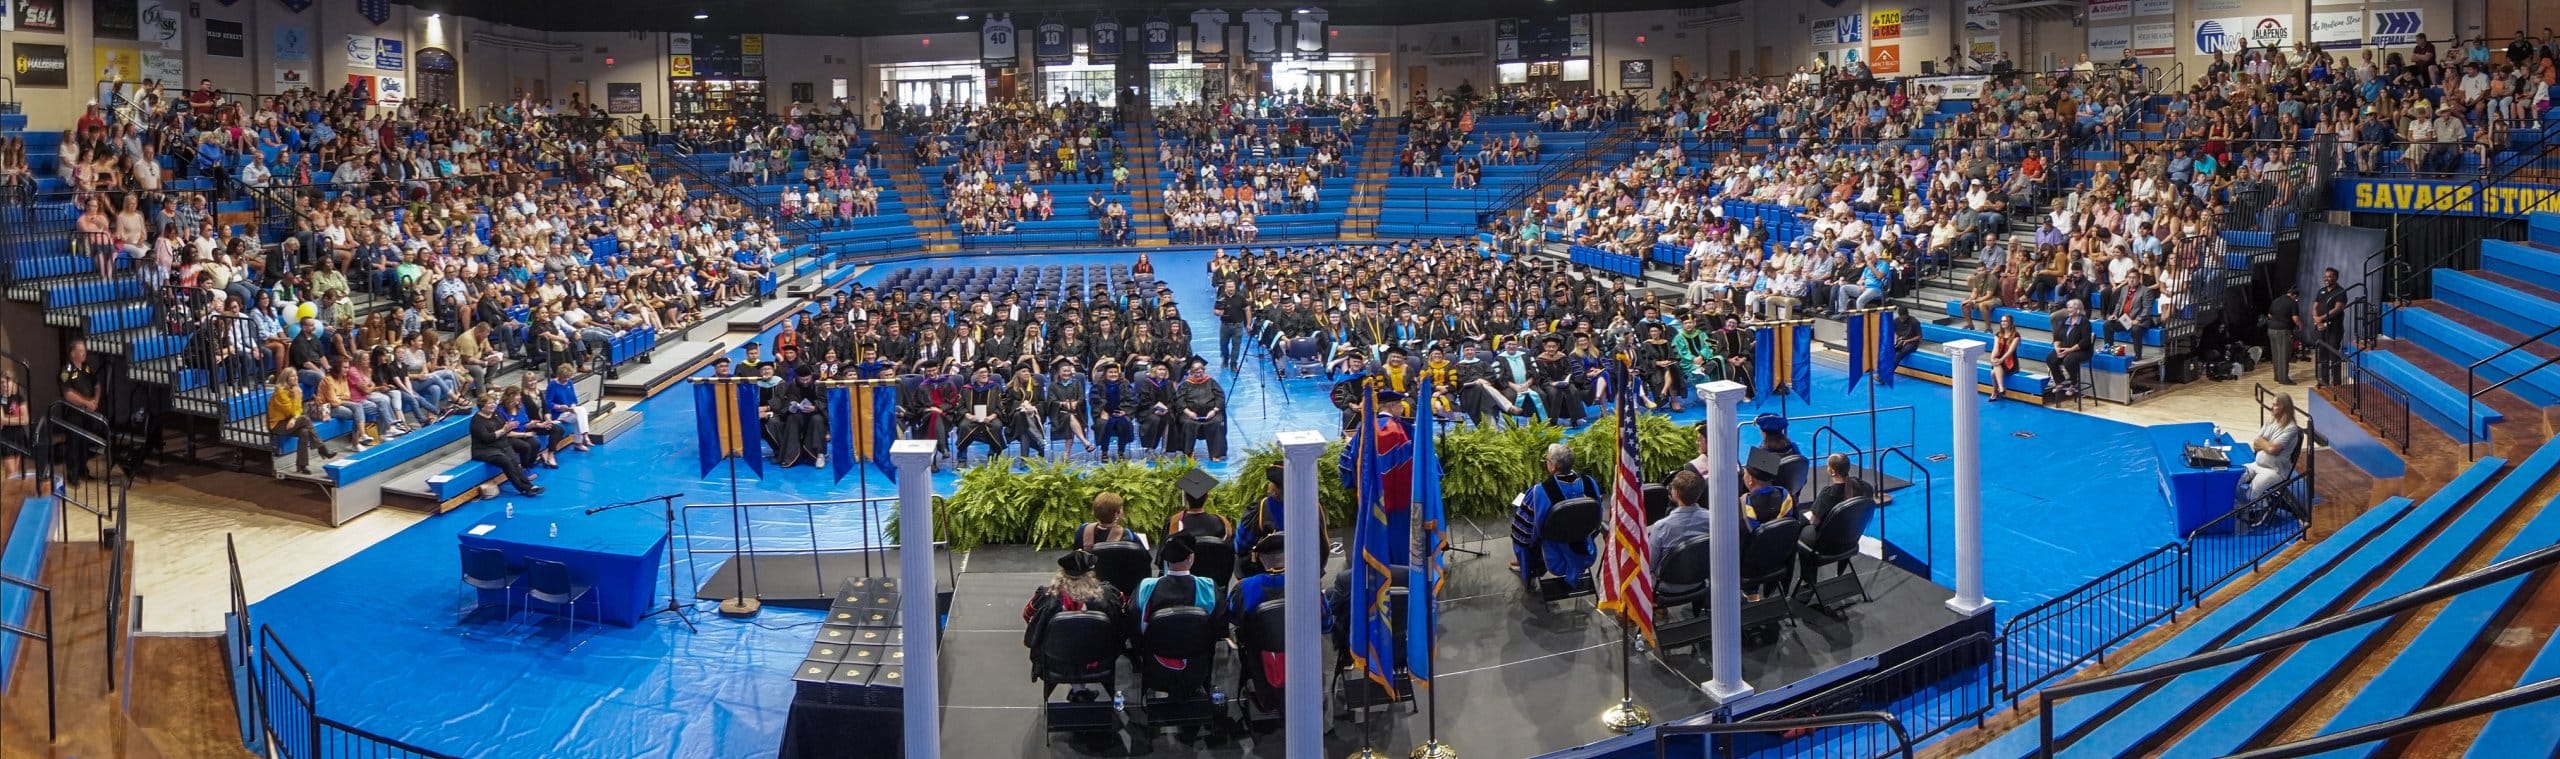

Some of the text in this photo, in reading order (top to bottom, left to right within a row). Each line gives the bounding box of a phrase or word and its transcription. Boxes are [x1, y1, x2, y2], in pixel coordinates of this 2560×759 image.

[1881, 13, 1899, 25] TACO
[1098, 29, 1115, 44] 34
[1148, 29, 1167, 43] 30
[1882, 25, 1899, 36] CASA
[990, 31, 1007, 45] 40
[1045, 31, 1060, 46] 10
[2370, 35, 2405, 46] HOFFMAN
[2355, 182, 2474, 213] SAVAGE
